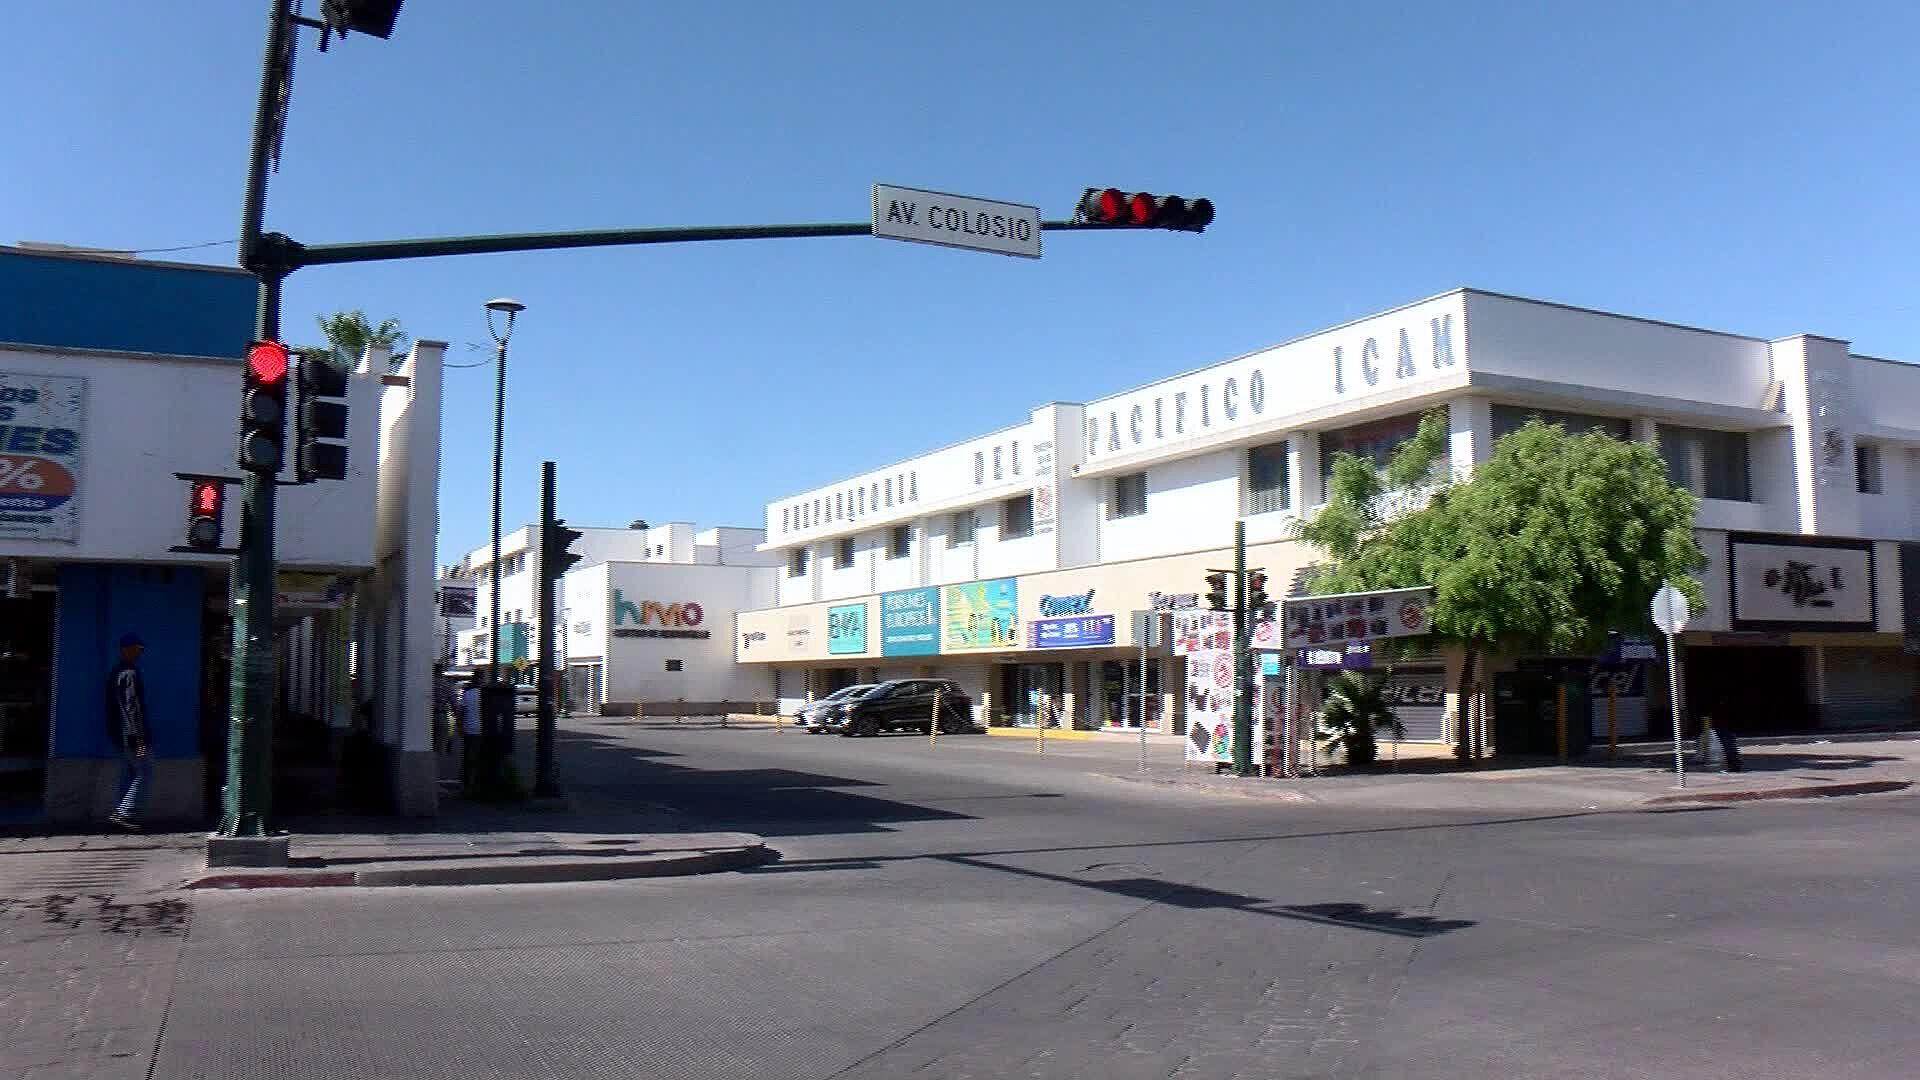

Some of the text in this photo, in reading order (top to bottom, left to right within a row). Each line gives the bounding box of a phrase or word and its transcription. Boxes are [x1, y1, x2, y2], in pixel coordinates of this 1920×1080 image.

[886, 199, 1032, 242] AV. COLOSIO
[781, 470, 920, 534] PREPARATORIA
[973, 440, 1022, 485] DEL
[1088, 368, 1266, 456] PACIFICO
[612, 587, 706, 627] hmo
